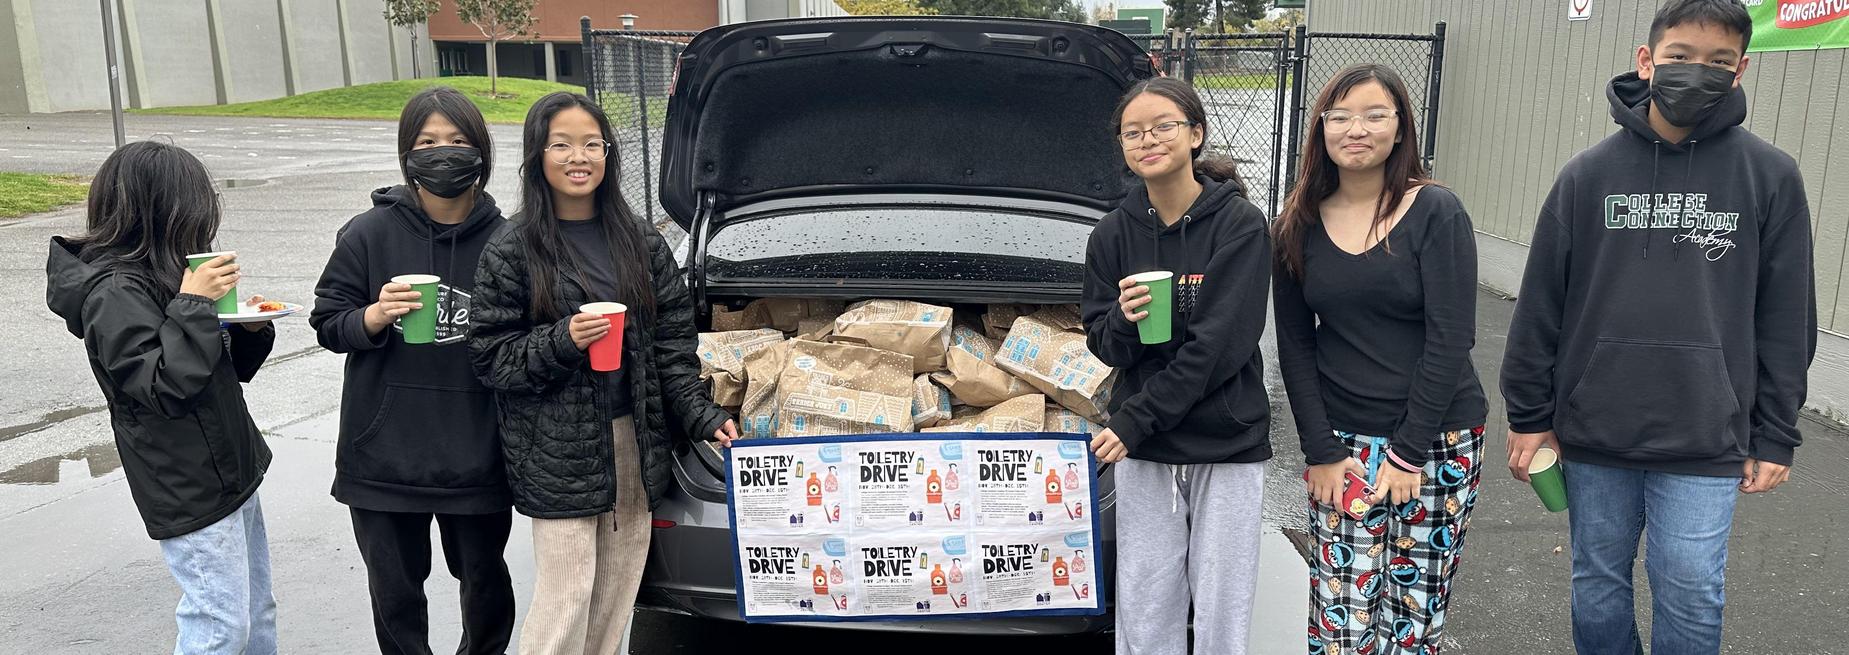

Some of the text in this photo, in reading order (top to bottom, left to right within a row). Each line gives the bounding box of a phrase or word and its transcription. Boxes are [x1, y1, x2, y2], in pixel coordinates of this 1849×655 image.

[1605, 194, 1707, 228] COLLEGE
[1673, 226, 1736, 261] Academy
[738, 455, 794, 469] TOILETRY
[859, 451, 914, 464] TOILETRY
[978, 450, 1032, 462] TOILETRY
[740, 469, 788, 486] DRIVE
[860, 465, 908, 482] DRIVE
[980, 464, 1027, 481] DRIVE
[746, 547, 800, 558] TOILETRY
[862, 546, 918, 559] TOILETRY
[982, 543, 1039, 557] TOILETRY
[749, 559, 795, 574] DRIVE
[864, 560, 912, 576] DRIVE
[983, 556, 1033, 574] DRIVE
